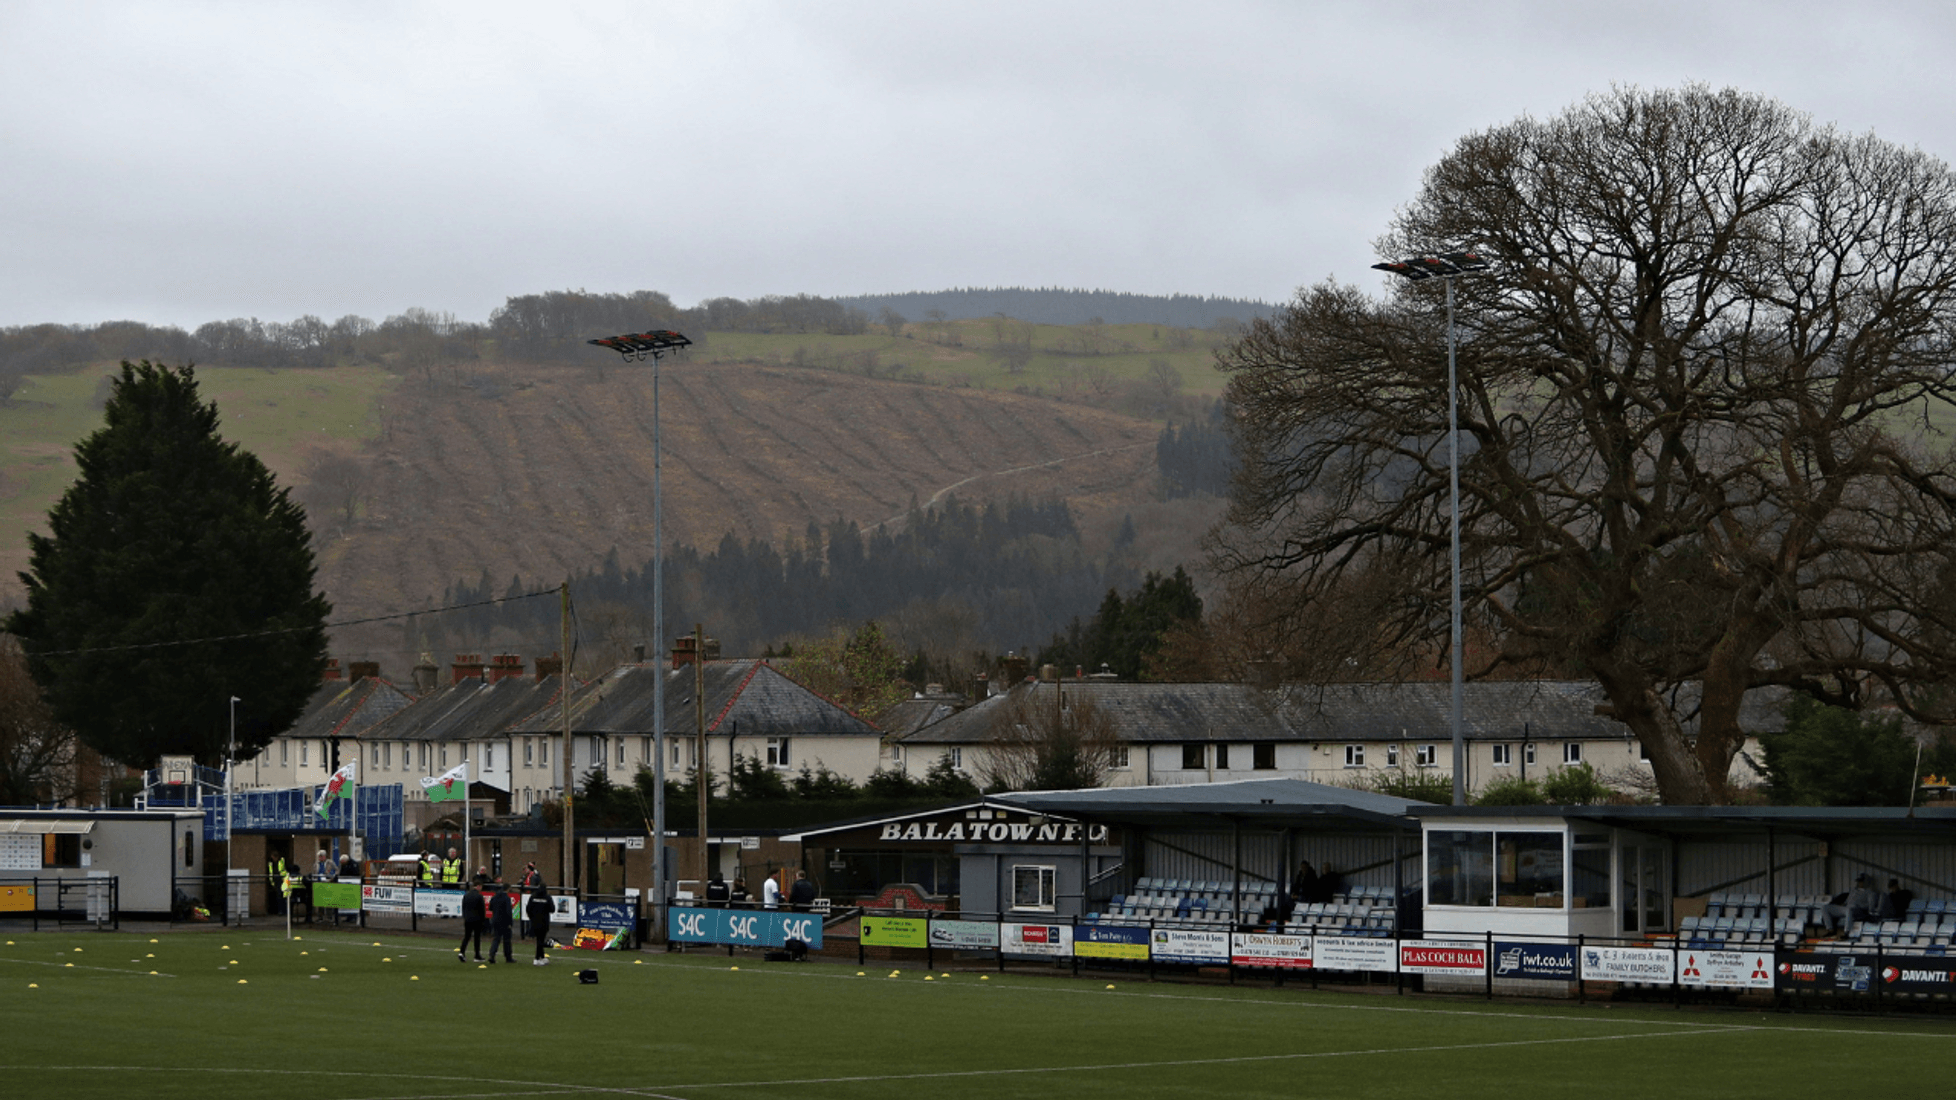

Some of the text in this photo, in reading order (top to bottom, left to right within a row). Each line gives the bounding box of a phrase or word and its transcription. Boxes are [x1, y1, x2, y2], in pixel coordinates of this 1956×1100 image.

[879, 822, 966, 840] BALA
[374, 887, 393, 900] FUW
[678, 913, 705, 936] S4C
[729, 915, 758, 939] S4C
[783, 918, 812, 942] S4C
[1403, 950, 1483, 965] PLAS COCH BALA
[1523, 952, 1573, 968] iwt.co.uk
[1606, 963, 1666, 974] FAMILY BUTCHERS
